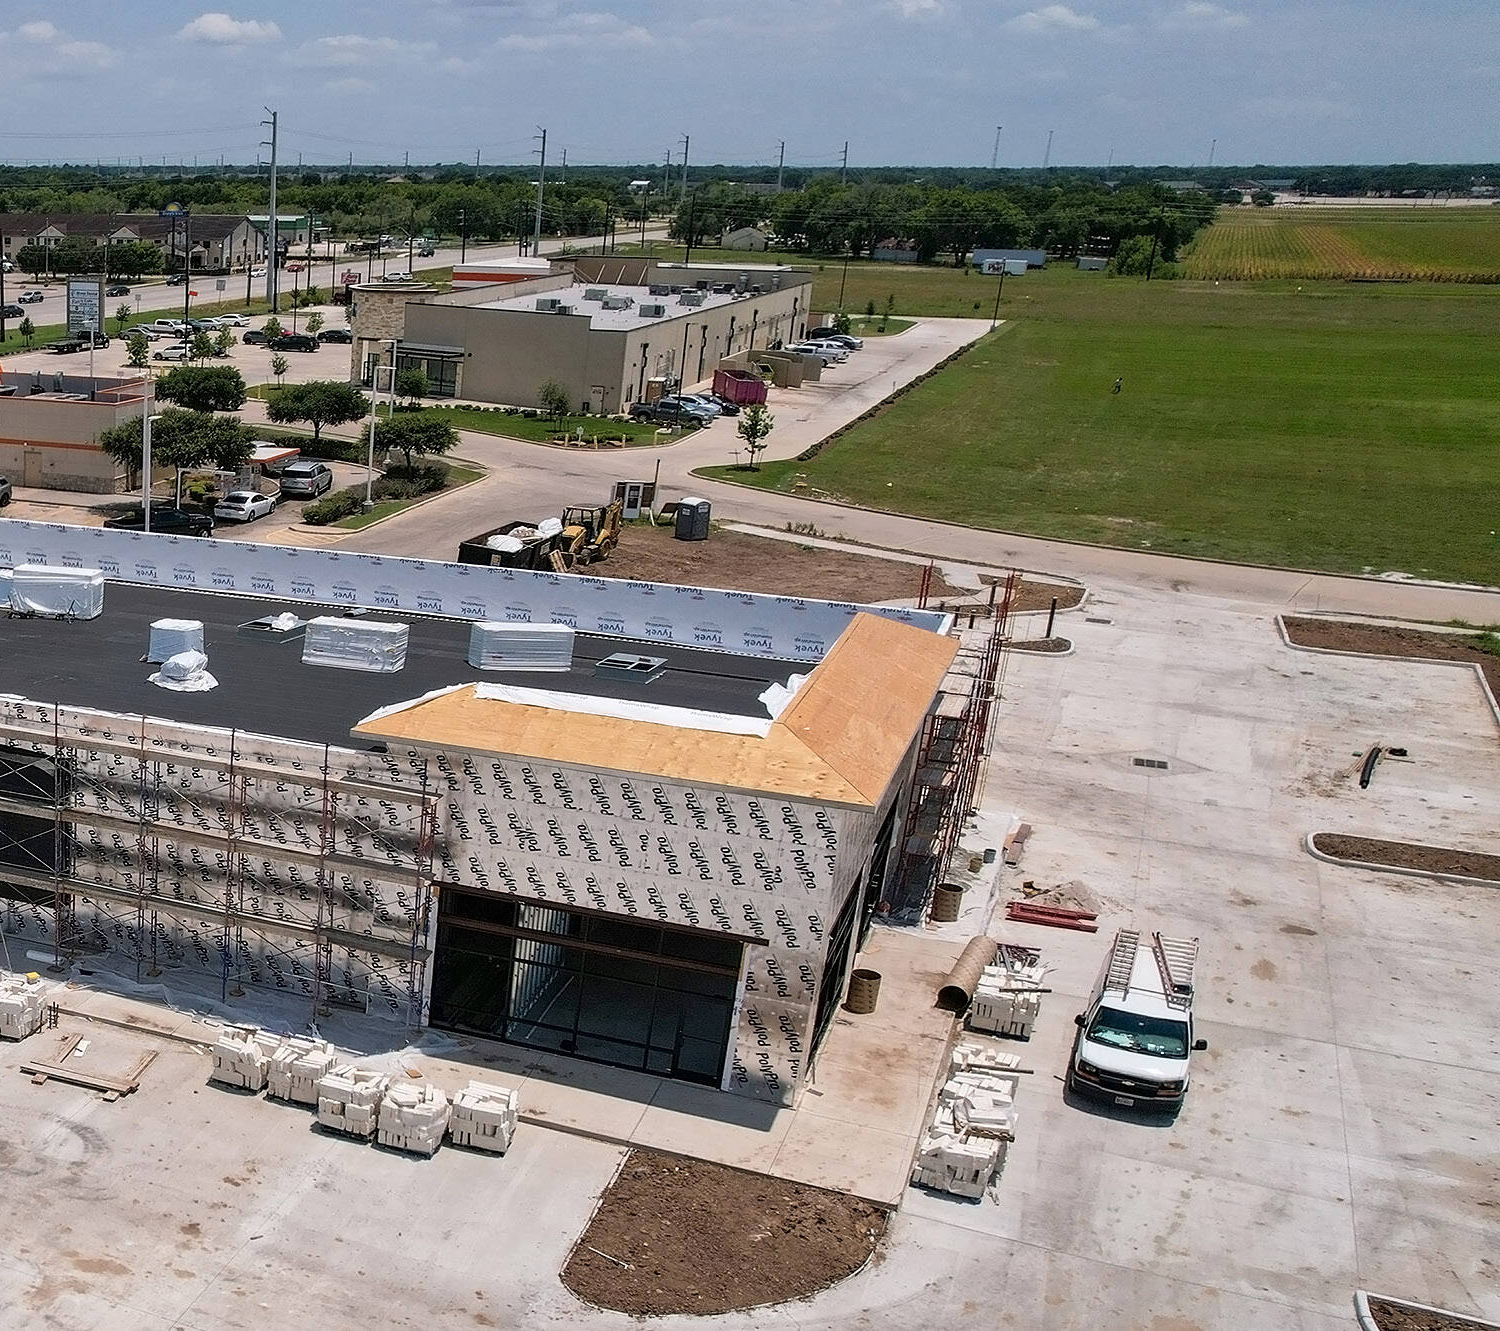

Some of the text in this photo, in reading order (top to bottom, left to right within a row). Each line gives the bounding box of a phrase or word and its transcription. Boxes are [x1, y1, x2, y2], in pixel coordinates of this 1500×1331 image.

[136, 570, 157, 579] Tyvek
[174, 574, 196, 583] Tyvek
[212, 578, 235, 587] Tyvek
[251, 582, 275, 591] Tyvek
[291, 588, 316, 596] Tyvek
[333, 592, 357, 601] Tyvek
[374, 597, 399, 606] Tyvek
[417, 602, 442, 611] Tyvek
[461, 607, 486, 617] Tyvek
[506, 613, 532, 622] Tyvek
[551, 618, 577, 628] Tyvek
[598, 624, 625, 633] Tyvek
[646, 628, 673, 638] Tyvek
[694, 634, 722, 643] Tyvek
[744, 639, 773, 649] Tyvek
[795, 645, 825, 655] Tyvek
[437, 755, 460, 791] PolyPro
[463, 759, 486, 795] PolyPro
[492, 763, 516, 800] PolyPro
[522, 768, 546, 804] PolyPro
[552, 773, 577, 810] PolyPro
[589, 778, 614, 815] PolyPro
[620, 783, 645, 820] PolyPro
[652, 788, 677, 825] PolyPro
[167, 799, 185, 826] olyPro
[379, 800, 400, 826] PolyP
[449, 804, 473, 840] PolyPro
[477, 808, 502, 845] PolyPro
[685, 792, 708, 830] PolyPro
[715, 797, 740, 835] PolyPro
[748, 801, 773, 840] PolyPro
[781, 806, 806, 846] PolyPro
[344, 828, 364, 858] olyPro
[547, 820, 571, 856] PolyPro
[577, 825, 601, 862] PolyPro
[815, 812, 837, 850] PolyPro
[608, 830, 632, 867] PolyPro
[657, 837, 681, 875] PolyPro
[688, 841, 713, 880] PolyPro
[440, 851, 461, 882] olyPro
[469, 857, 489, 888] olyPro
[497, 862, 517, 894] olyPro
[526, 867, 547, 899] olyPro
[720, 847, 745, 886] PolyPro
[790, 850, 816, 889] PolyPro
[556, 872, 577, 905] olyPro
[586, 877, 606, 911] olyPro
[616, 882, 637, 916] olyPro
[647, 888, 668, 922] olyPro
[678, 893, 700, 927] olyPro
[710, 898, 732, 932] olyPro
[743, 904, 764, 938] olyPro
[775, 909, 800, 949] PolyPro
[766, 959, 792, 998] PolyPro
[747, 1009, 771, 1047] PolyPro
[779, 1015, 803, 1053] PolyPro
[756, 1052, 780, 1090] PolyPro
